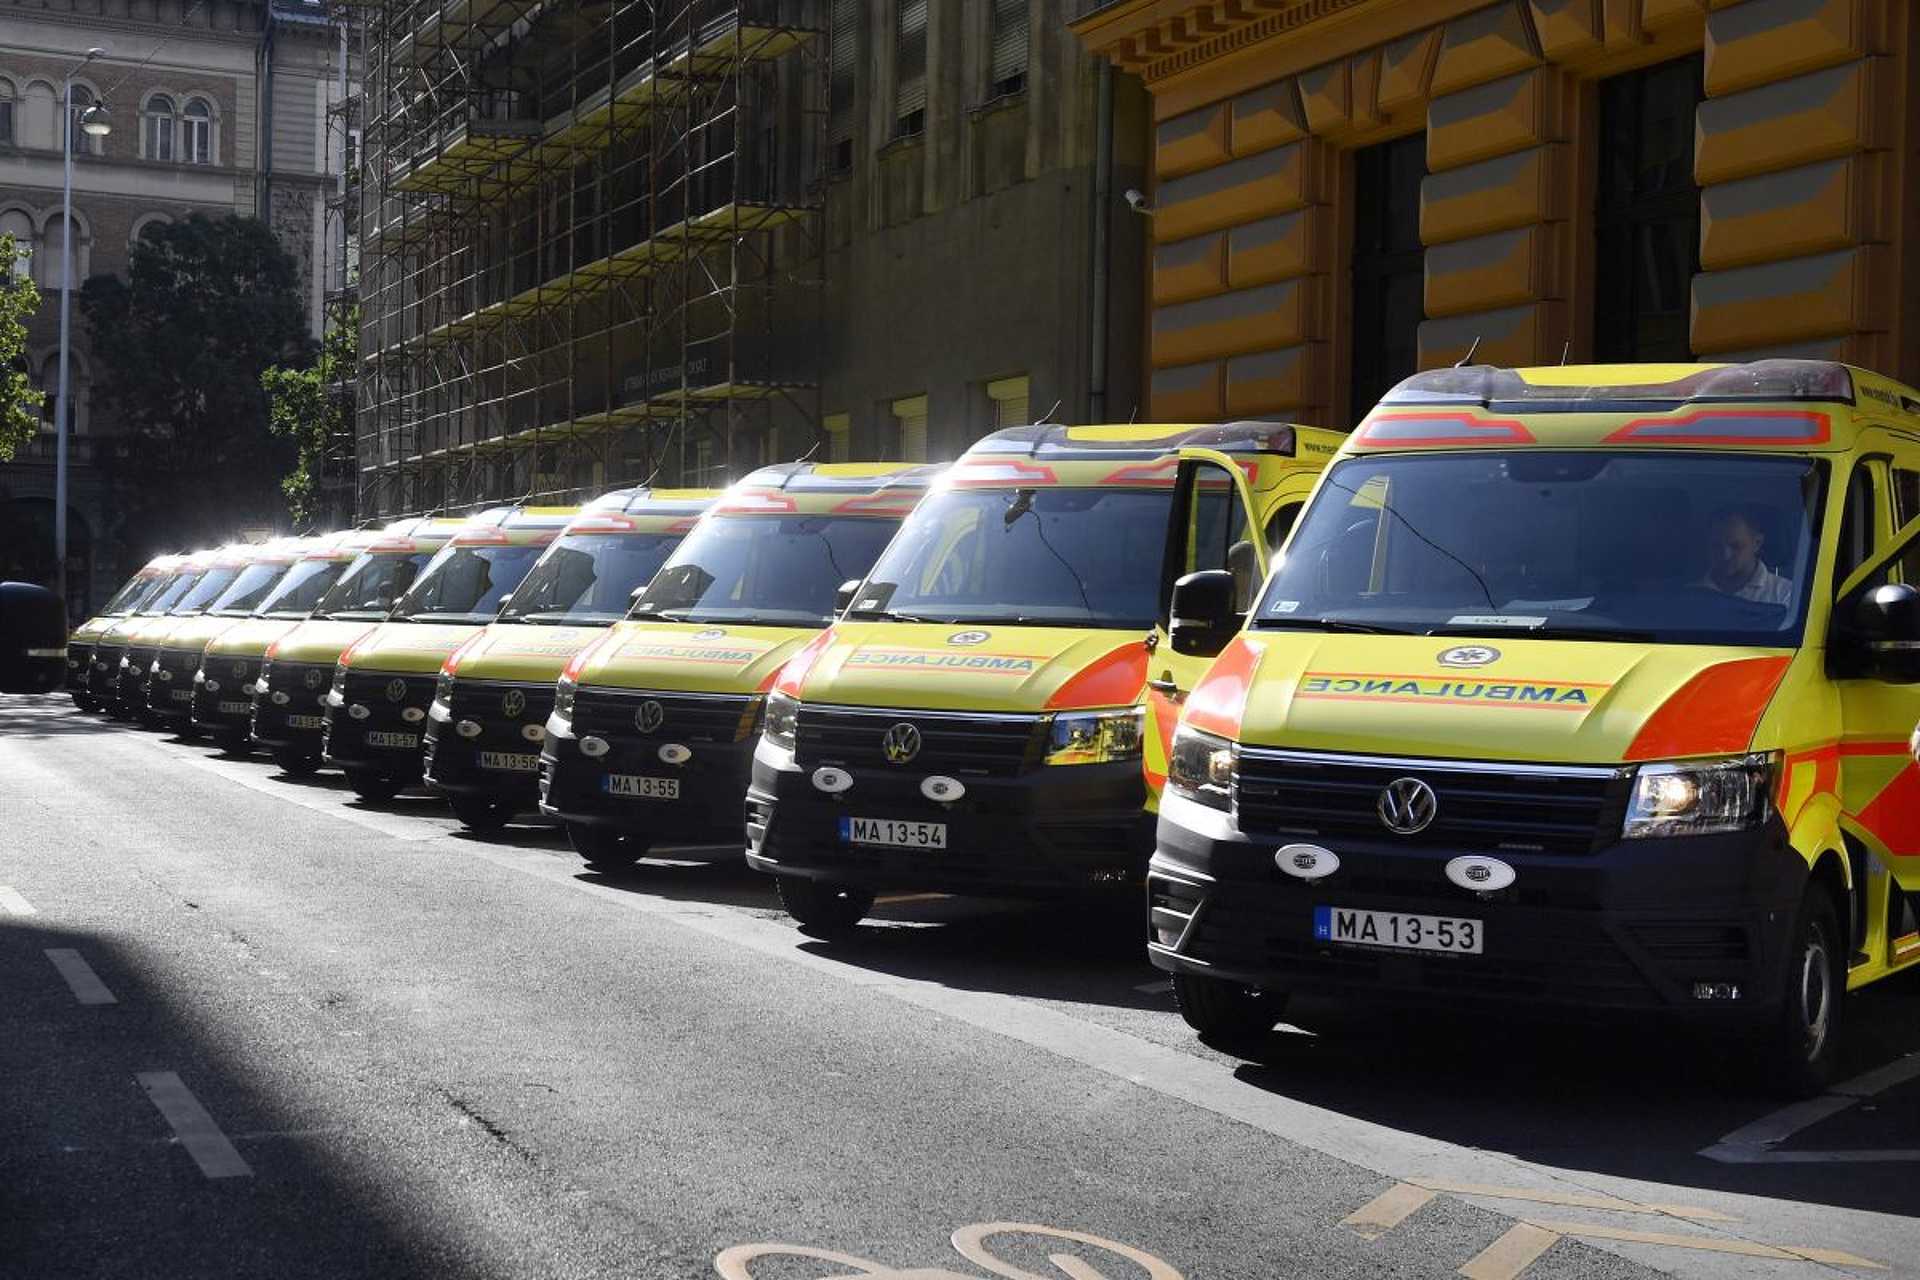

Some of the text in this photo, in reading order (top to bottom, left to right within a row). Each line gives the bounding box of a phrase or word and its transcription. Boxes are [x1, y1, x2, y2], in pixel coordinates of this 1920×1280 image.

[610, 776, 677, 796] MA 13-55
[853, 821, 941, 846] MA 13-54
[1336, 911, 1475, 949] MA 13-53
